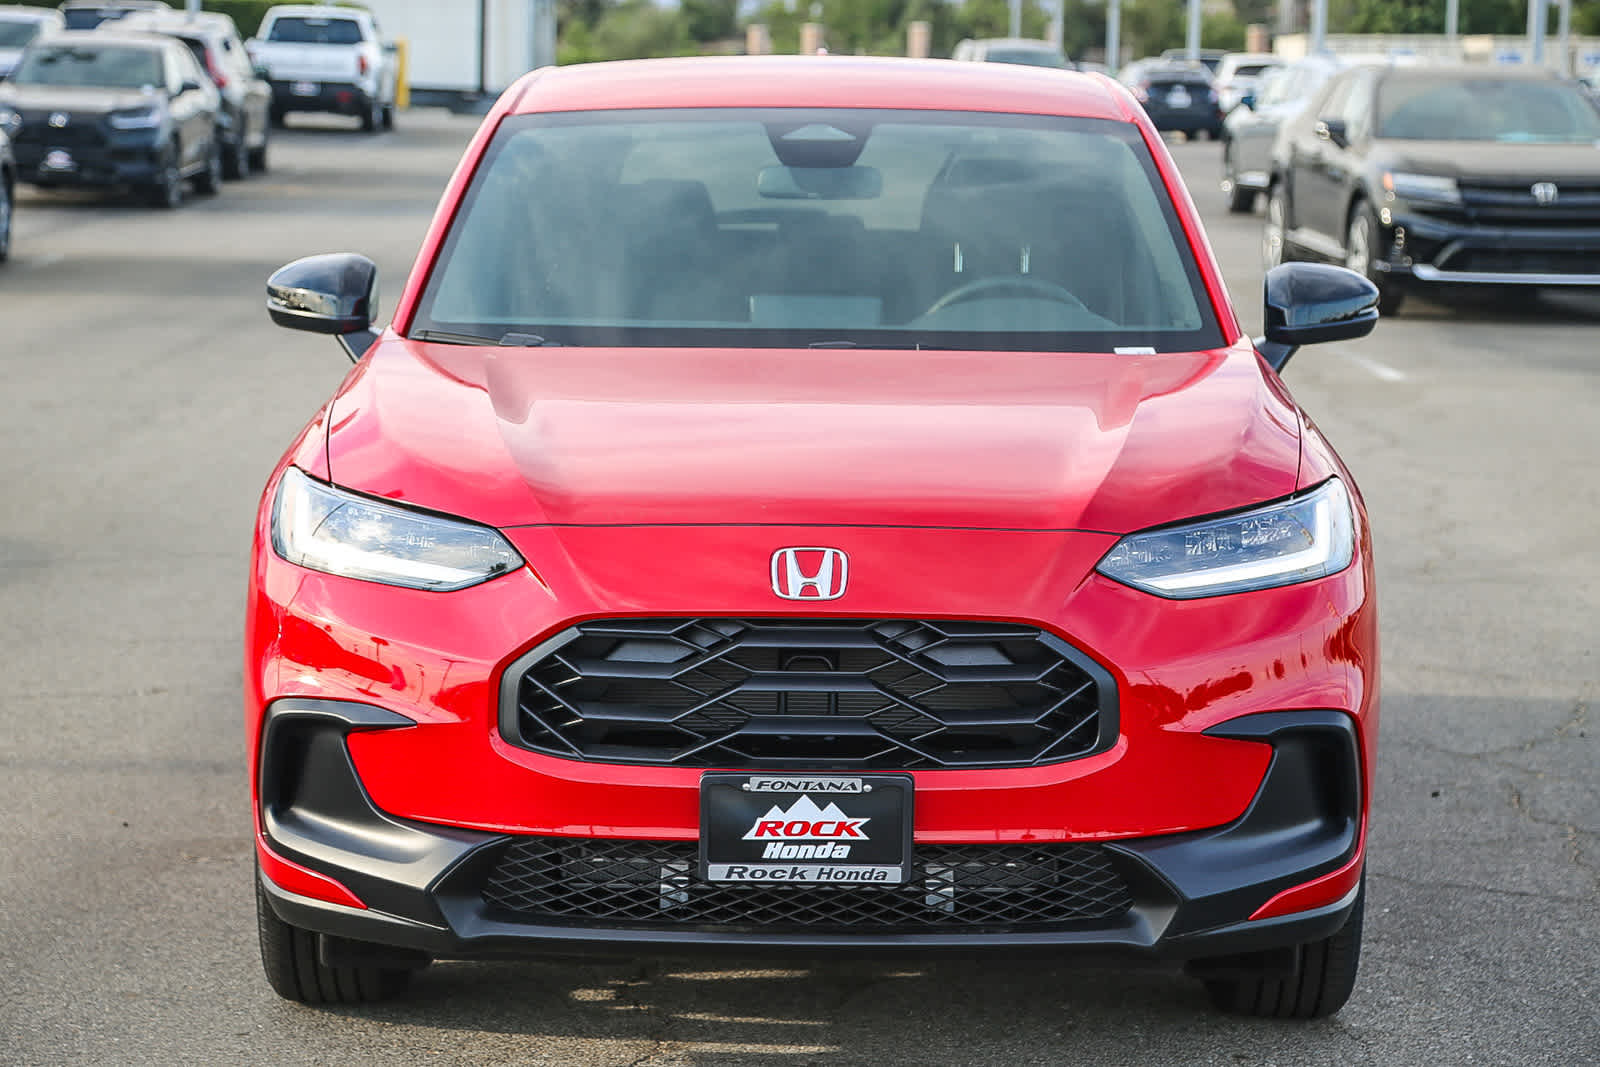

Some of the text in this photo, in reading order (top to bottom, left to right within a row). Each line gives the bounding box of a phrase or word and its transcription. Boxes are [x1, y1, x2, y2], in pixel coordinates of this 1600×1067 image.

[756, 780, 858, 792] FONTANA
[755, 820, 860, 837] ROCK
[762, 841, 851, 859] Honda
[725, 866, 888, 882] Rock Honda
